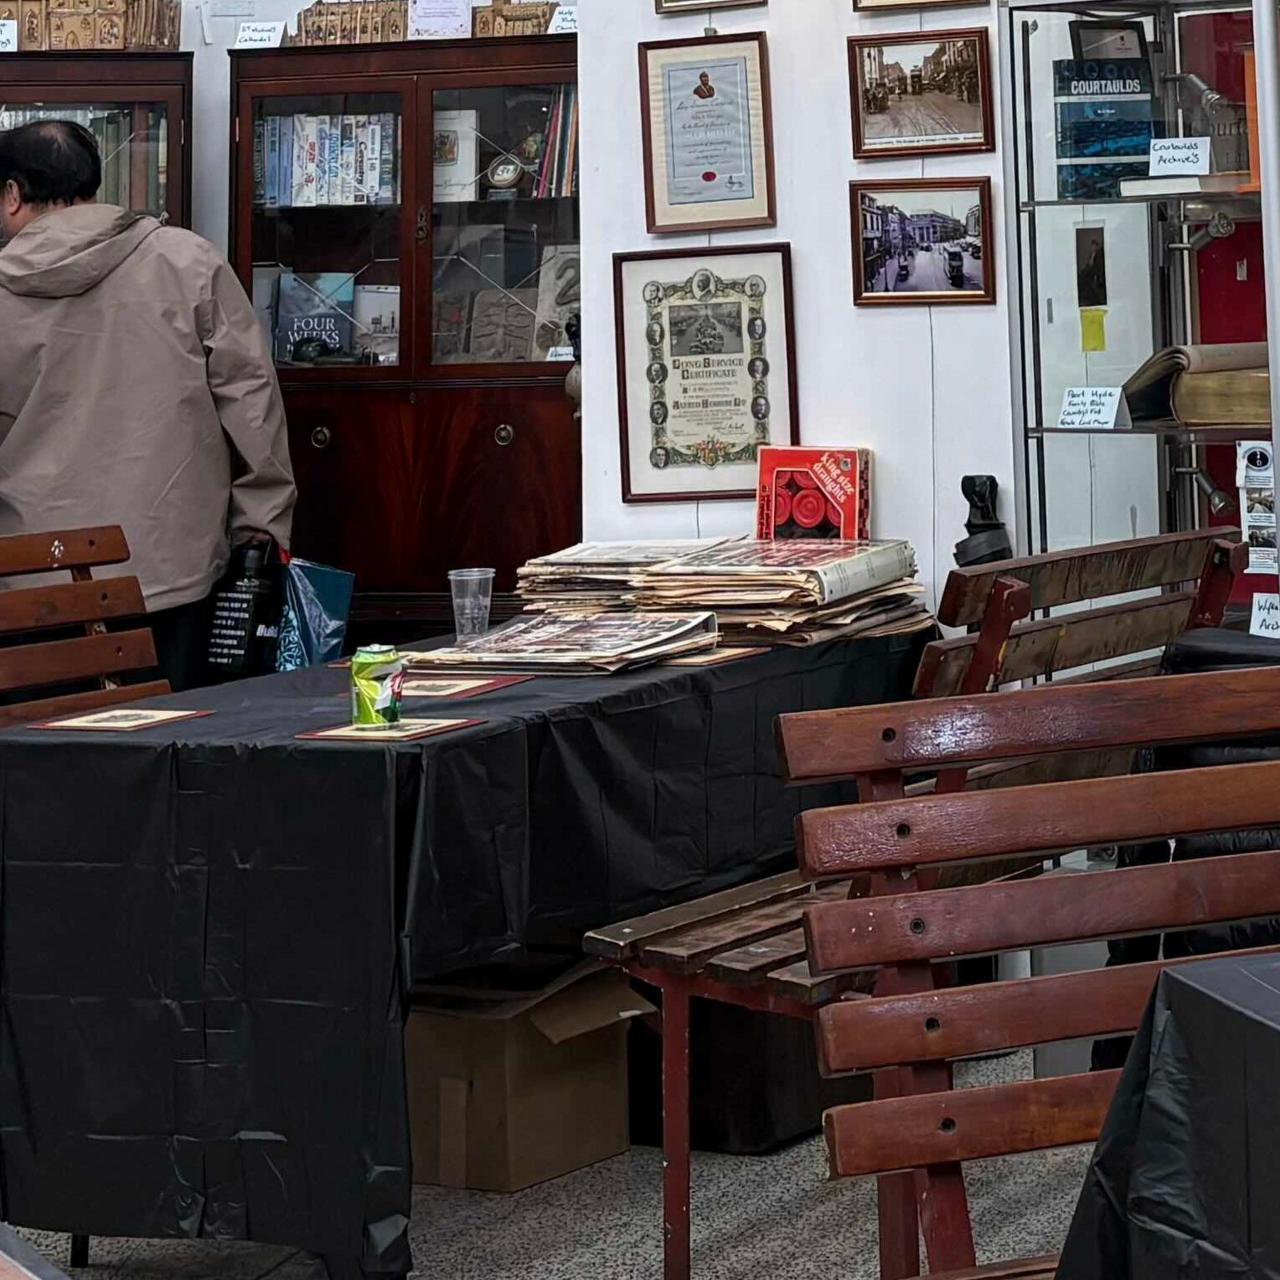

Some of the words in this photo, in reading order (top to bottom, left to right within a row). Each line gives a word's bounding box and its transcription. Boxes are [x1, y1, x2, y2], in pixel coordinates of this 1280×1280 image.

[1070, 78, 1142, 95] COURTAULDS
[293, 317, 336, 331] FOUR
[820, 451, 842, 479] King
[812, 461, 848, 504] draughts
